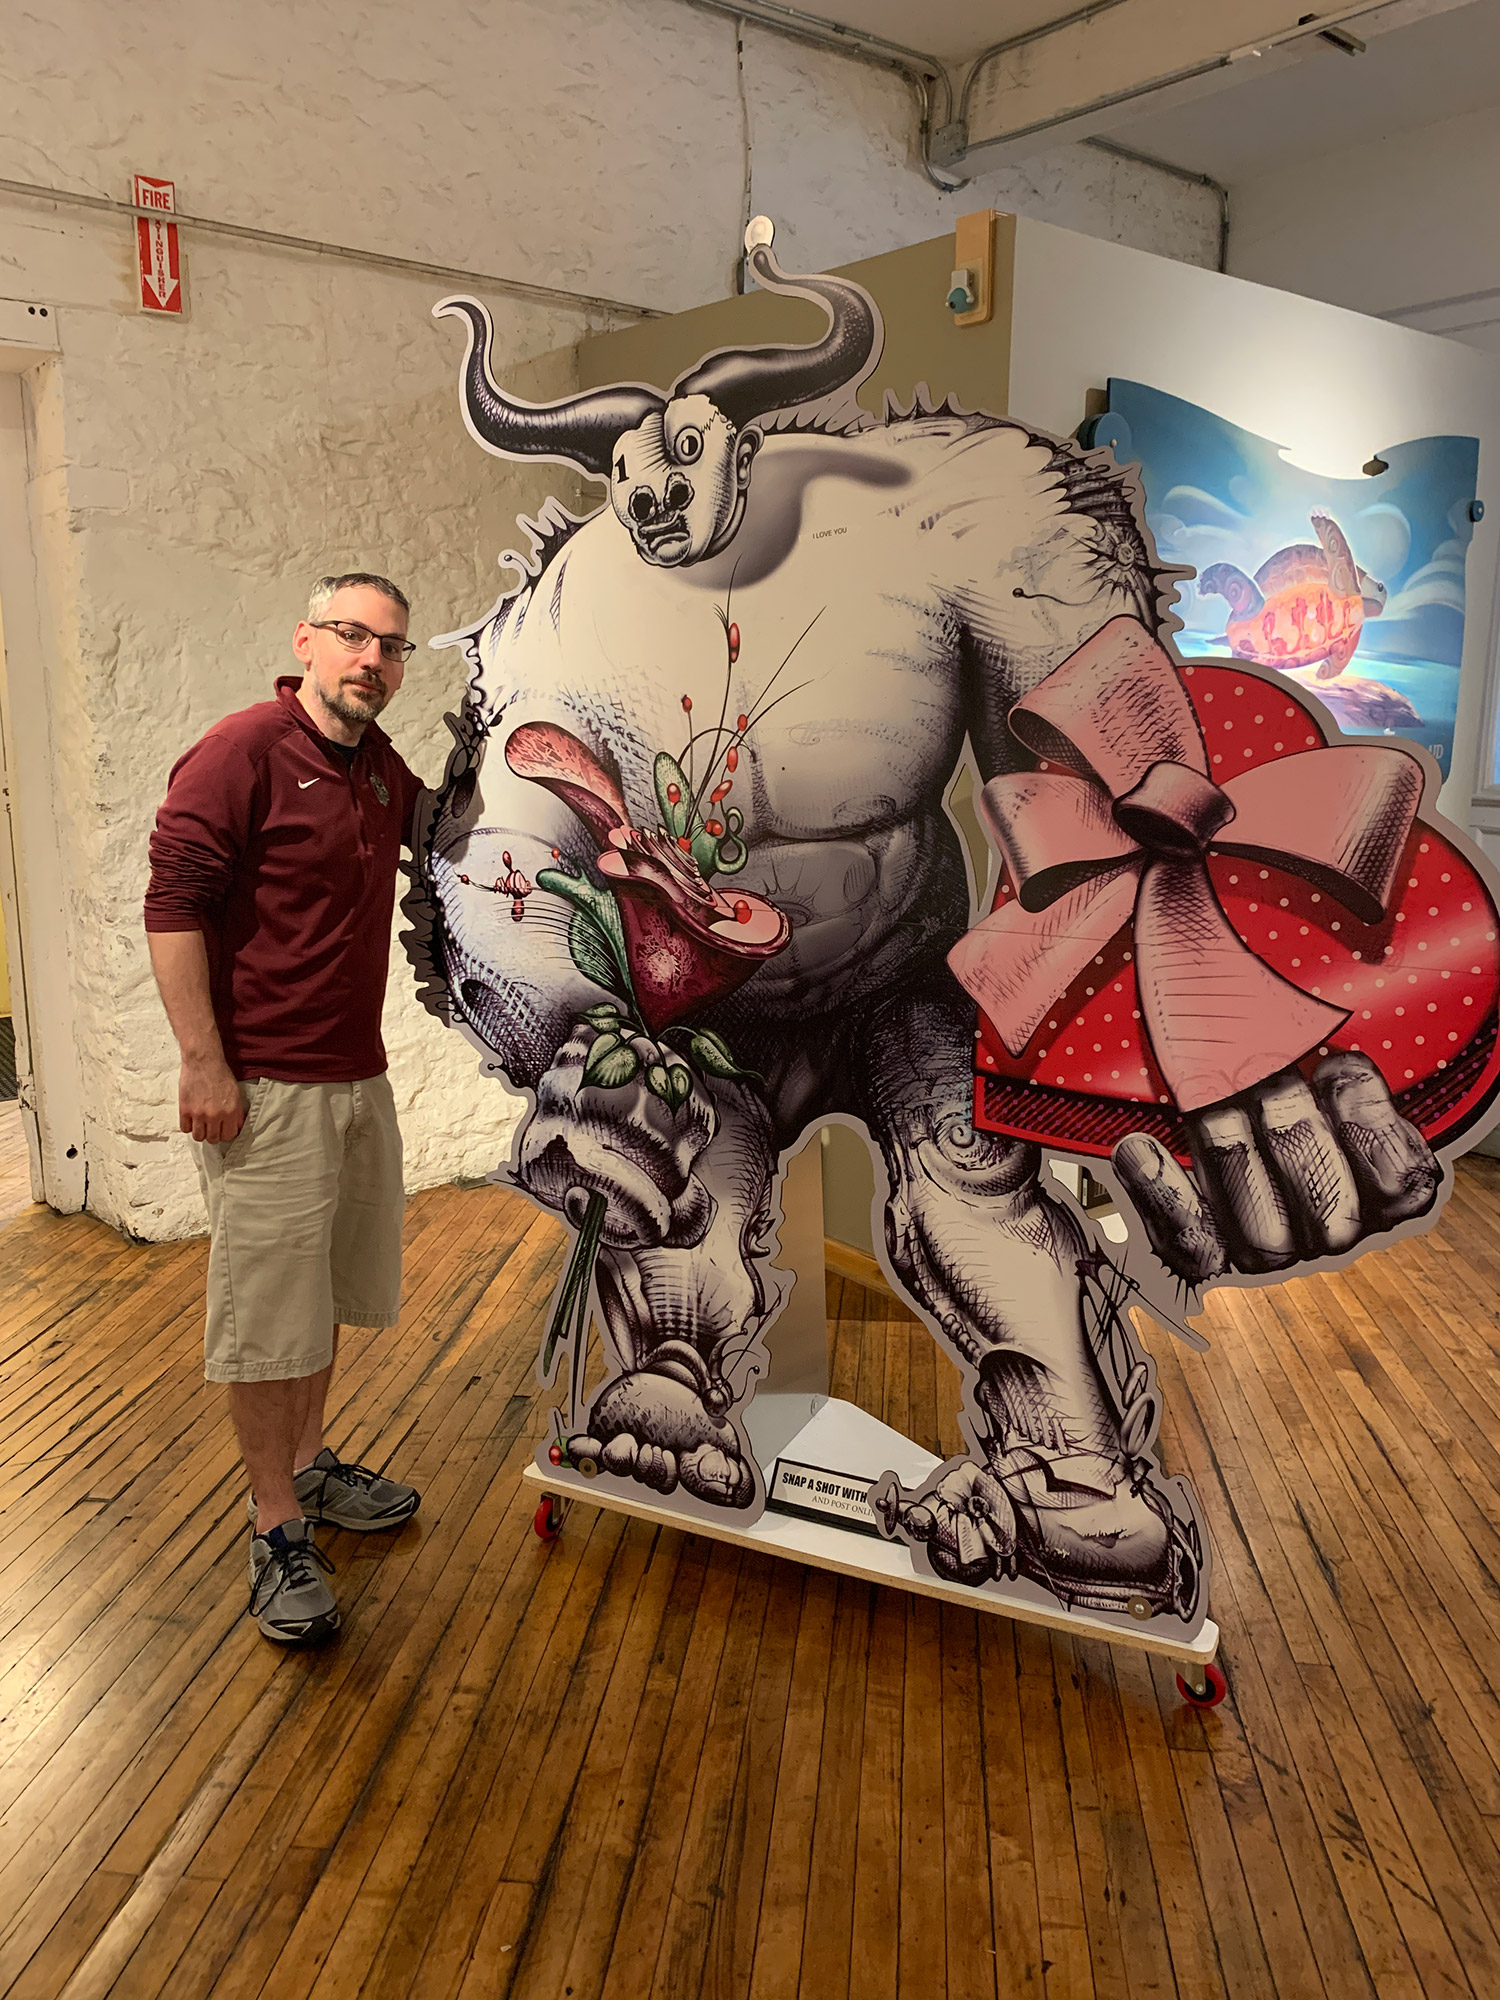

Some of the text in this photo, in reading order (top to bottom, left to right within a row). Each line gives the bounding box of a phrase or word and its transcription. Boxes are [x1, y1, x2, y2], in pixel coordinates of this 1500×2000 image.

[142, 188, 171, 210] FIRE
[155, 219, 167, 298] XTINGUISHER
[816, 530, 832, 539] LOVE
[833, 527, 847, 535] YOU
[782, 1472, 868, 1503] SNAP A SHOT WITH
[812, 1495, 830, 1505] AND
[831, 1499, 851, 1511] POST
